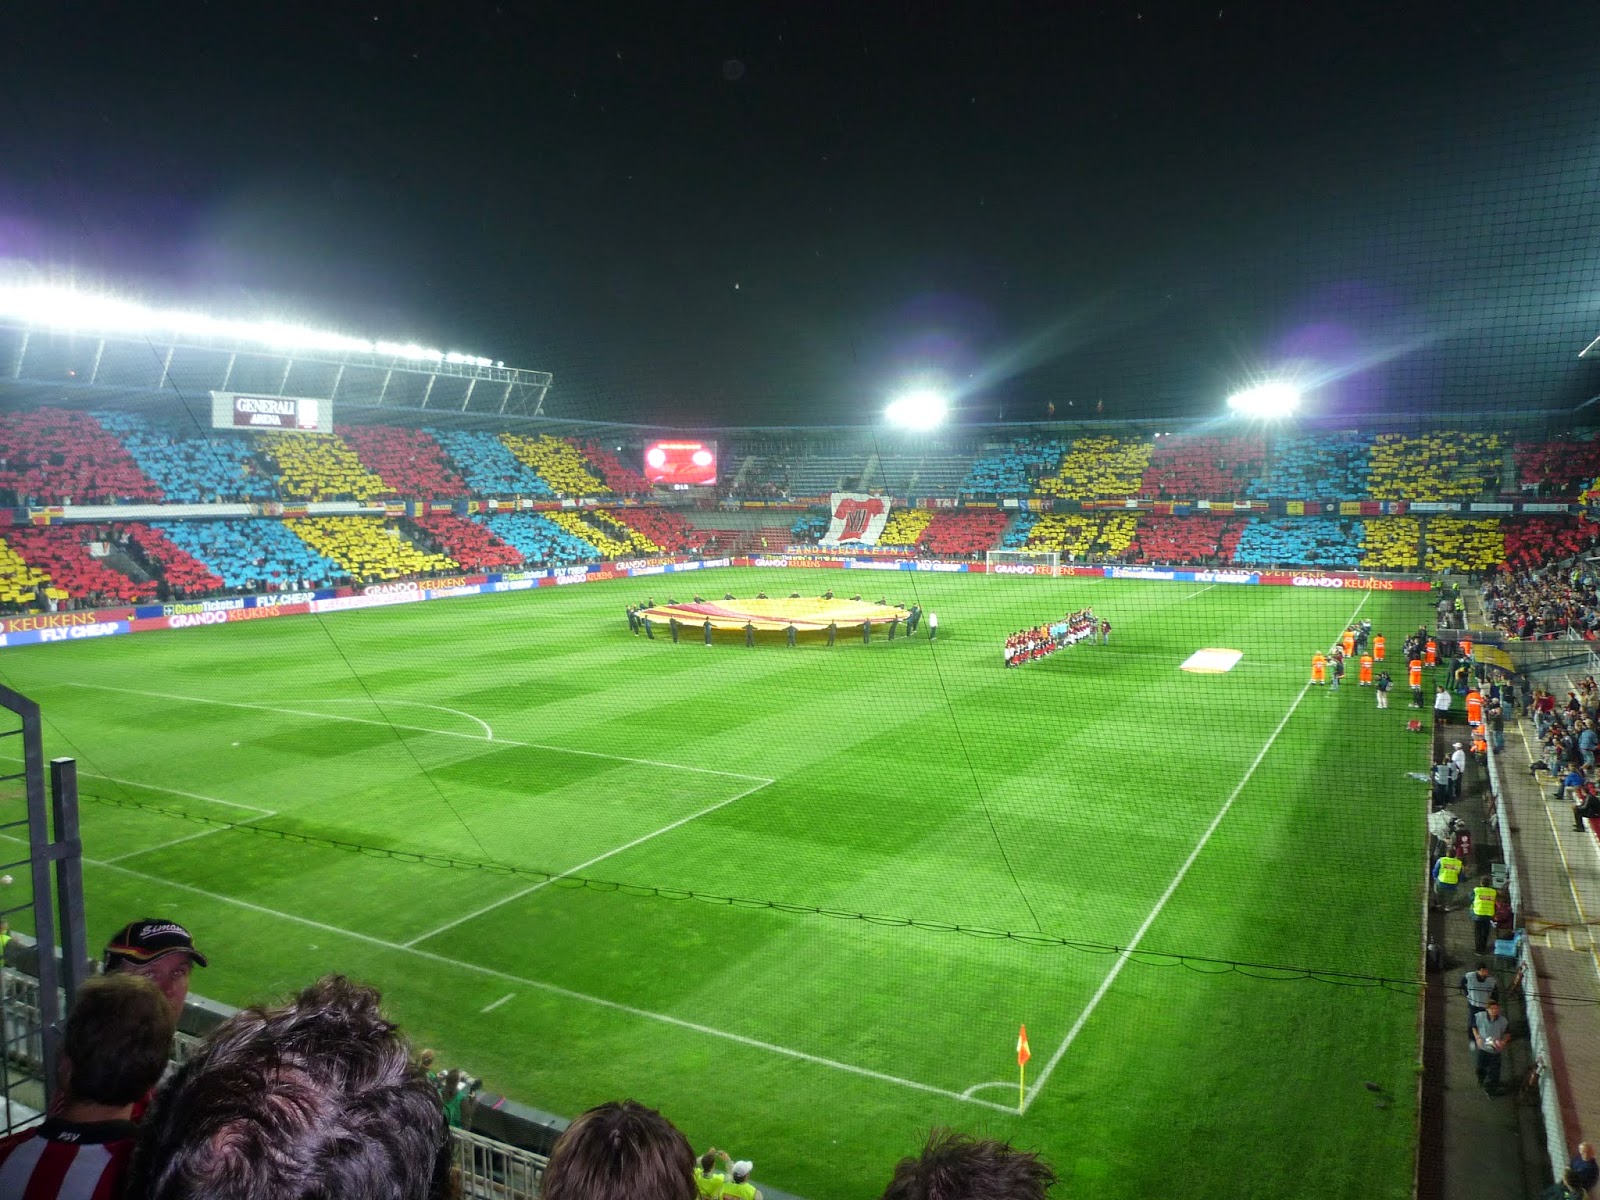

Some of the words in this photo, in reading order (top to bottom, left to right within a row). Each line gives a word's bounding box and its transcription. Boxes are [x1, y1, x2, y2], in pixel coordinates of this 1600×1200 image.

[236, 397, 295, 415] GENERALI
[249, 413, 282, 426] ARENA
[616, 559, 647, 571] GRANDO
[755, 559, 787, 567] GRANDO
[995, 564, 1034, 574] GRANDO
[1036, 564, 1075, 576] KEUKENS
[554, 567, 566, 577] FLY
[556, 573, 587, 585] GRANDO
[587, 571, 613, 582] KEUKENS
[364, 582, 417, 596] GRANDO
[418, 577, 466, 591] KEUKENS
[1292, 576, 1343, 588] GRANDO
[1344, 578, 1394, 590] KEUKENS
[256, 595, 279, 607] FLY
[280, 592, 316, 606] CHEAP
[9, 612, 96, 633] KEUKENS
[169, 611, 227, 628] GRANDO
[228, 606, 281, 622] KEUKENS
[40, 626, 70, 642] FLY
[70, 621, 120, 638] CHEAP
